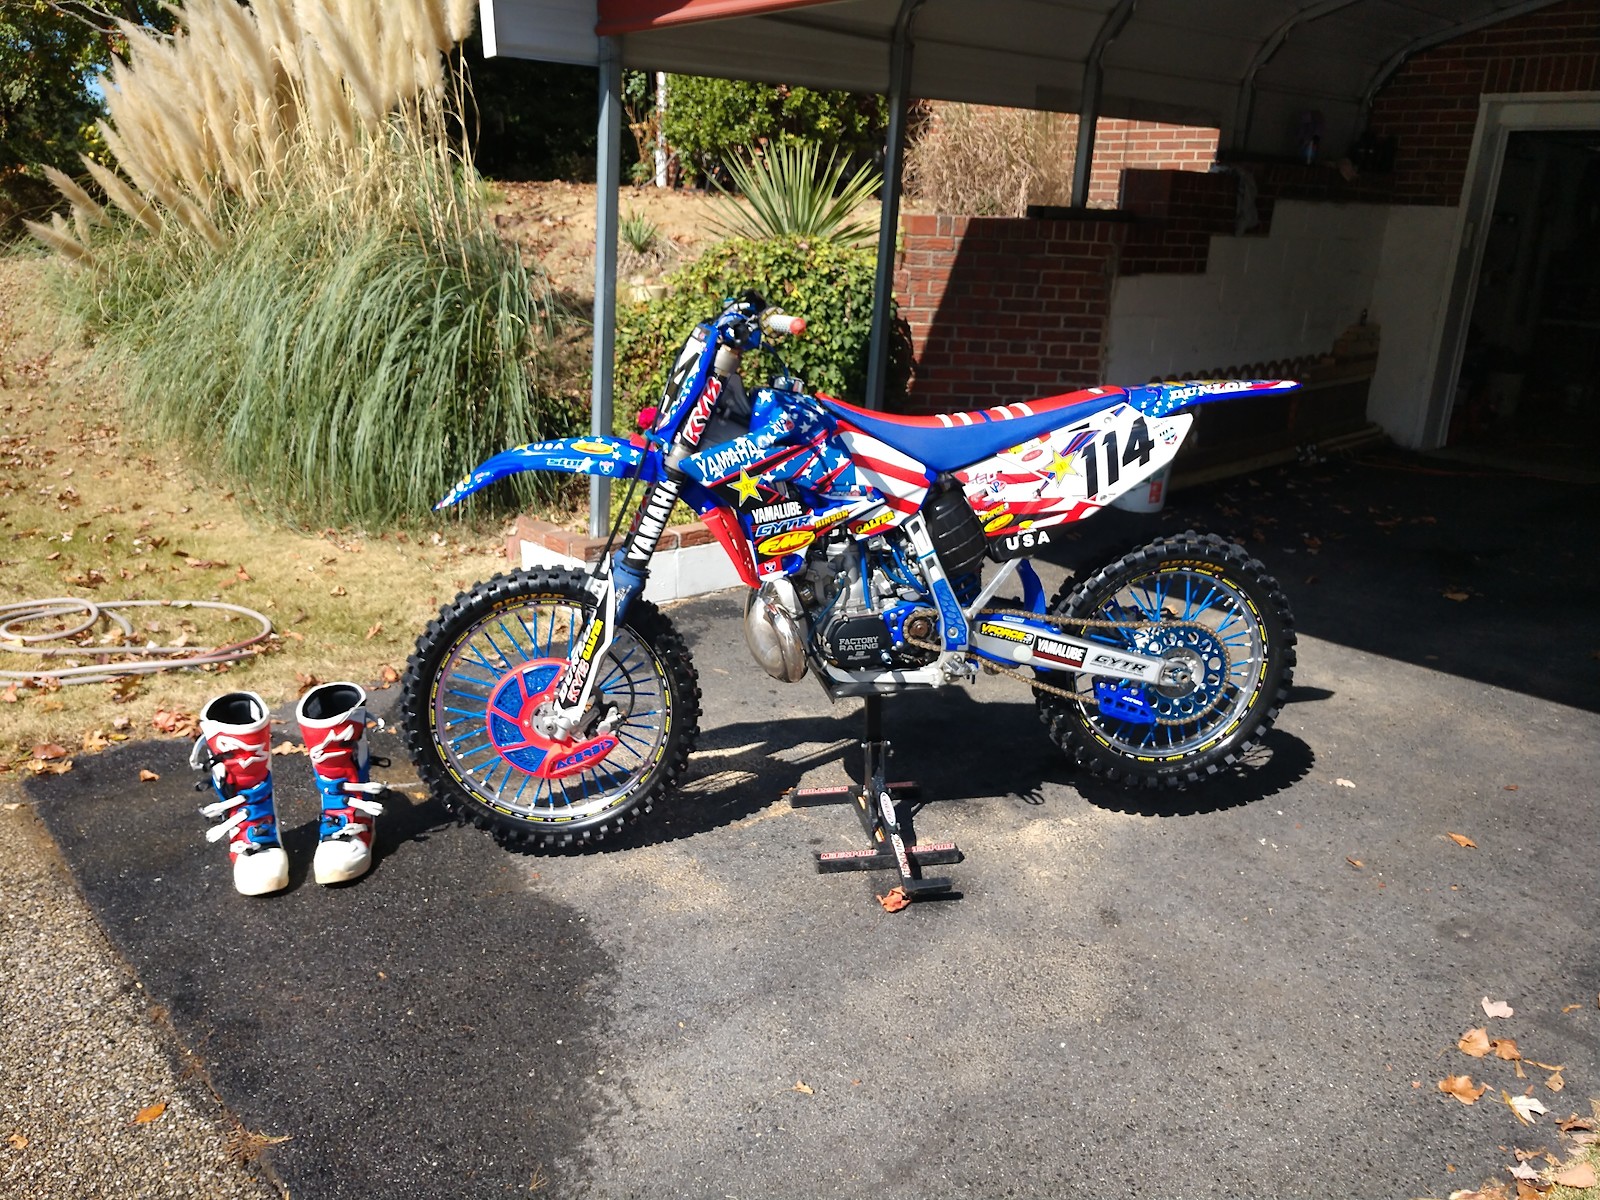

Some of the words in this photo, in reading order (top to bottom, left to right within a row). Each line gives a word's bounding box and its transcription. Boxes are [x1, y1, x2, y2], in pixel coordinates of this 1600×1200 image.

[1170, 382, 1252, 401] DUNLOP
[682, 376, 722, 446] KYB
[533, 442, 564, 450] USA
[696, 439, 759, 478] YAMAHA
[1081, 416, 1155, 499] 114
[627, 480, 680, 560] YAMAHA
[751, 502, 802, 524] YAMALUBE
[814, 510, 849, 529] HINSON
[755, 515, 813, 537] GYTR
[759, 531, 815, 553] FMF
[1006, 531, 1050, 550] USA
[838, 636, 879, 645] FACTORY
[839, 643, 879, 651] RACING
[1037, 638, 1085, 661] YAMALUBE
[1092, 655, 1146, 673] GYTR
[556, 740, 614, 769] ACERBIS
